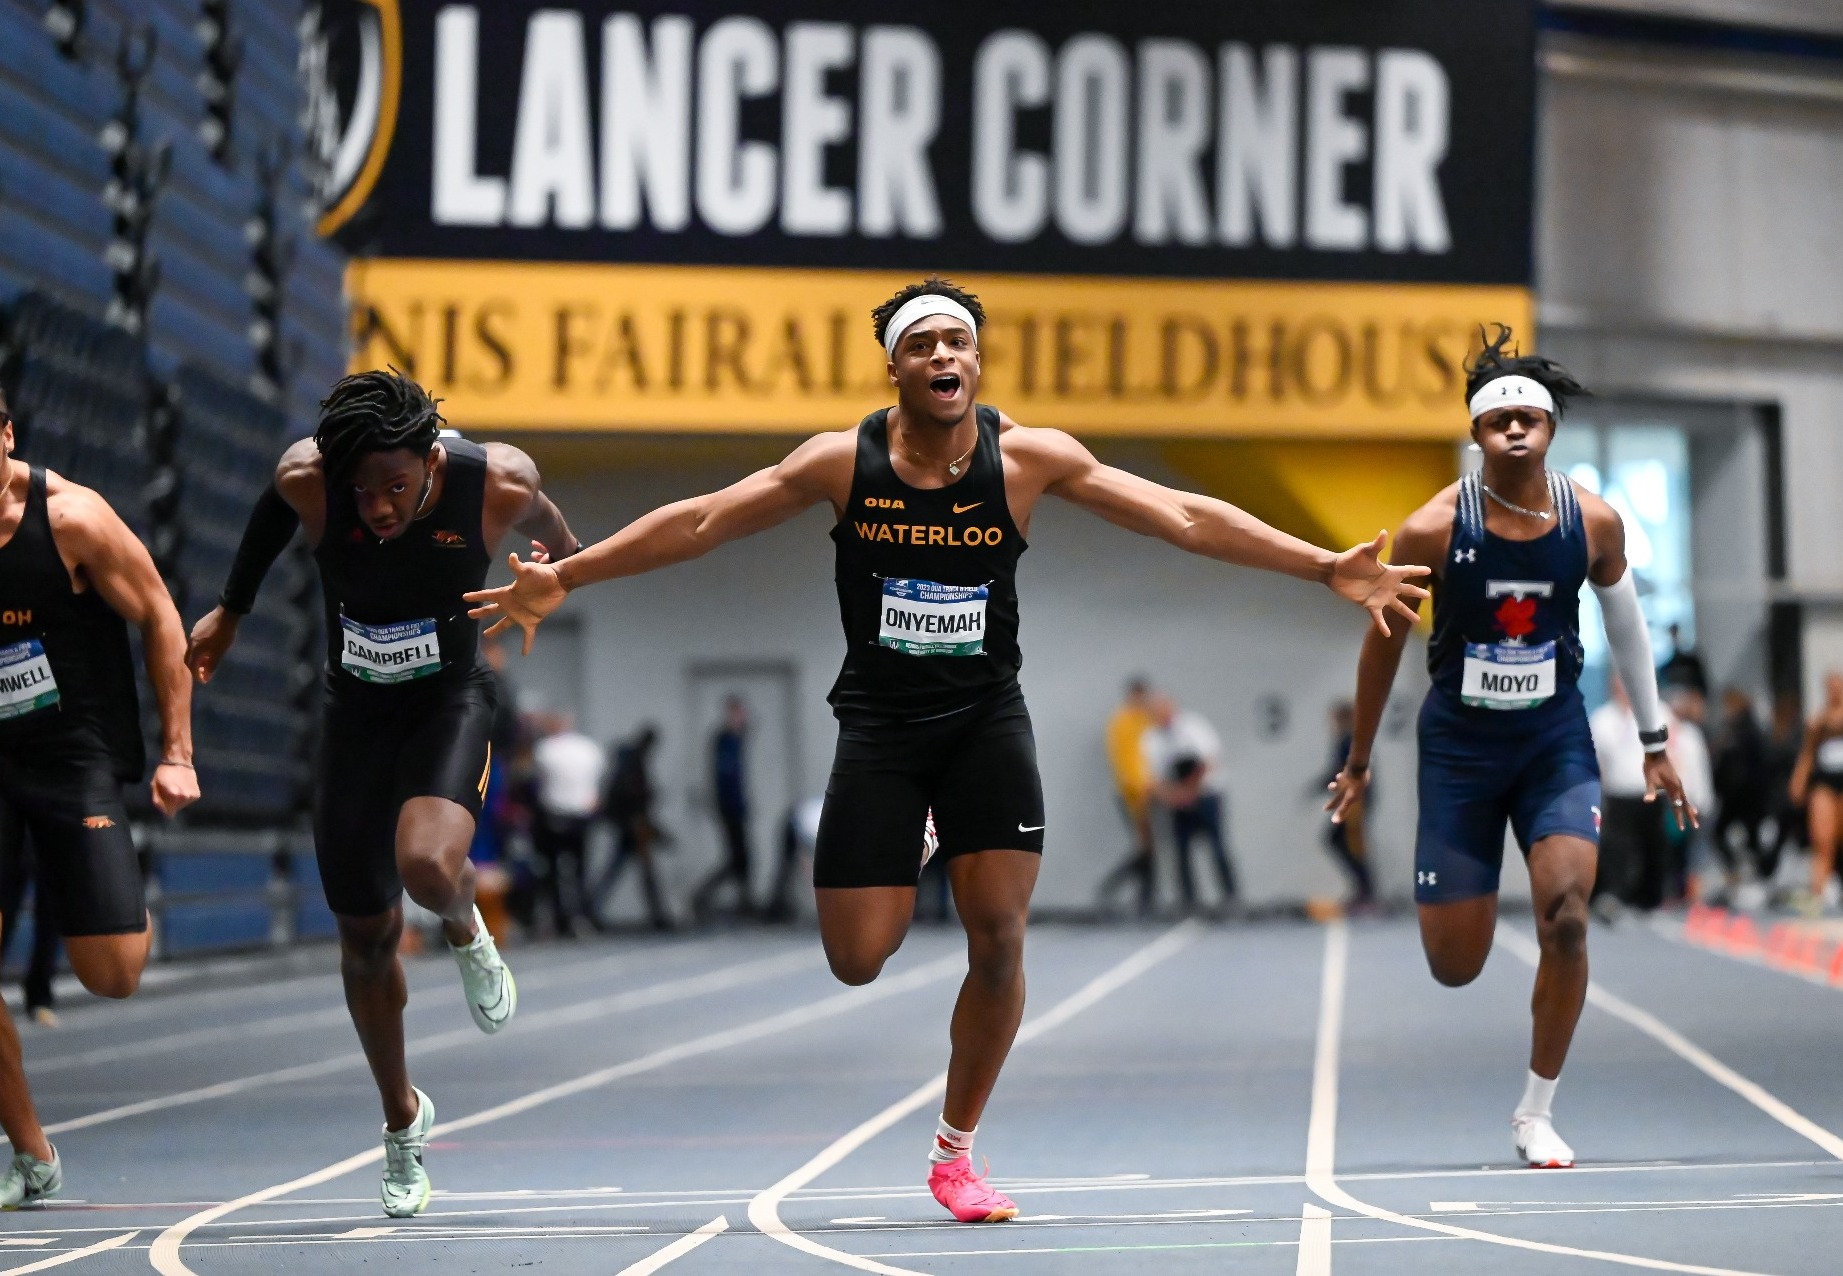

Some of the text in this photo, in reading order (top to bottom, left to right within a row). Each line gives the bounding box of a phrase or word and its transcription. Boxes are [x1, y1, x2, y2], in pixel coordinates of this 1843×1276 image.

[432, 4, 1452, 254] LANCER CORNER
[553, 304, 892, 393] FAIRAL
[864, 497, 905, 509] OUA
[854, 521, 1003, 546] WATERLOO
[920, 591, 973, 600] CHAMPIONSHIPS
[885, 607, 981, 634] ONYEMAH
[1481, 671, 1539, 692] MOYO
